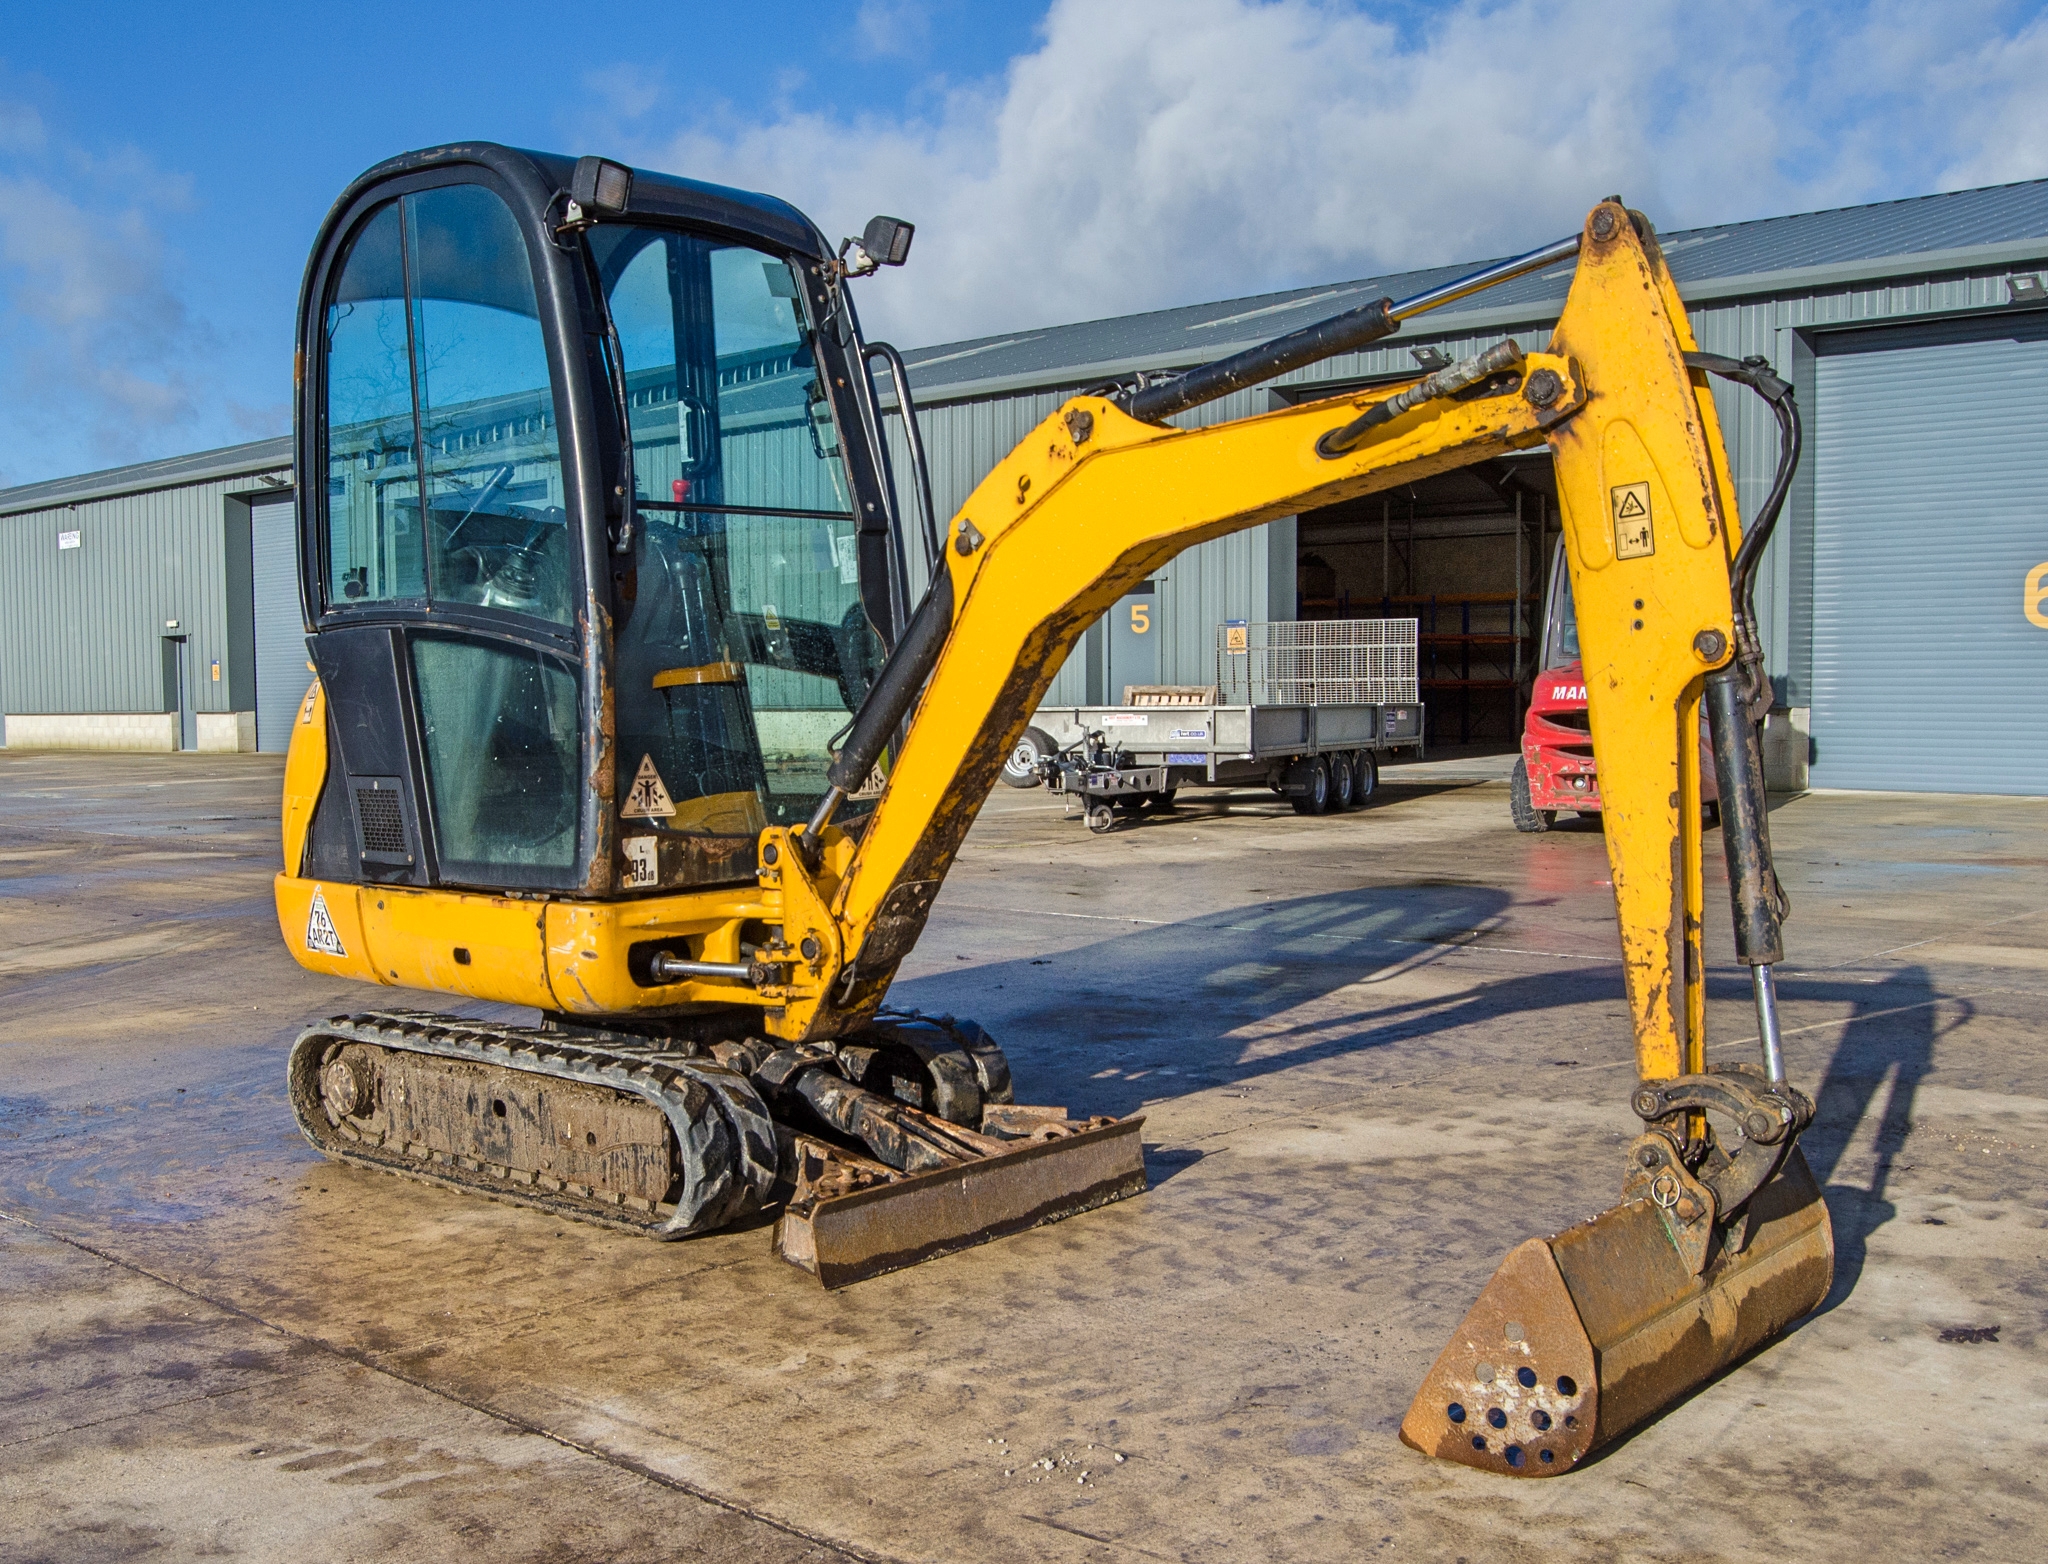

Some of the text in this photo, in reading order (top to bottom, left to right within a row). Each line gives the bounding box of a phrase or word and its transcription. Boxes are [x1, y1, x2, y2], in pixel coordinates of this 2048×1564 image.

[2024, 561, 2048, 629] 6
[1131, 604, 1150, 634] 5
[1551, 686, 1588, 700] MAN
[631, 859, 647, 881] 93
[315, 911, 326, 928] 76
